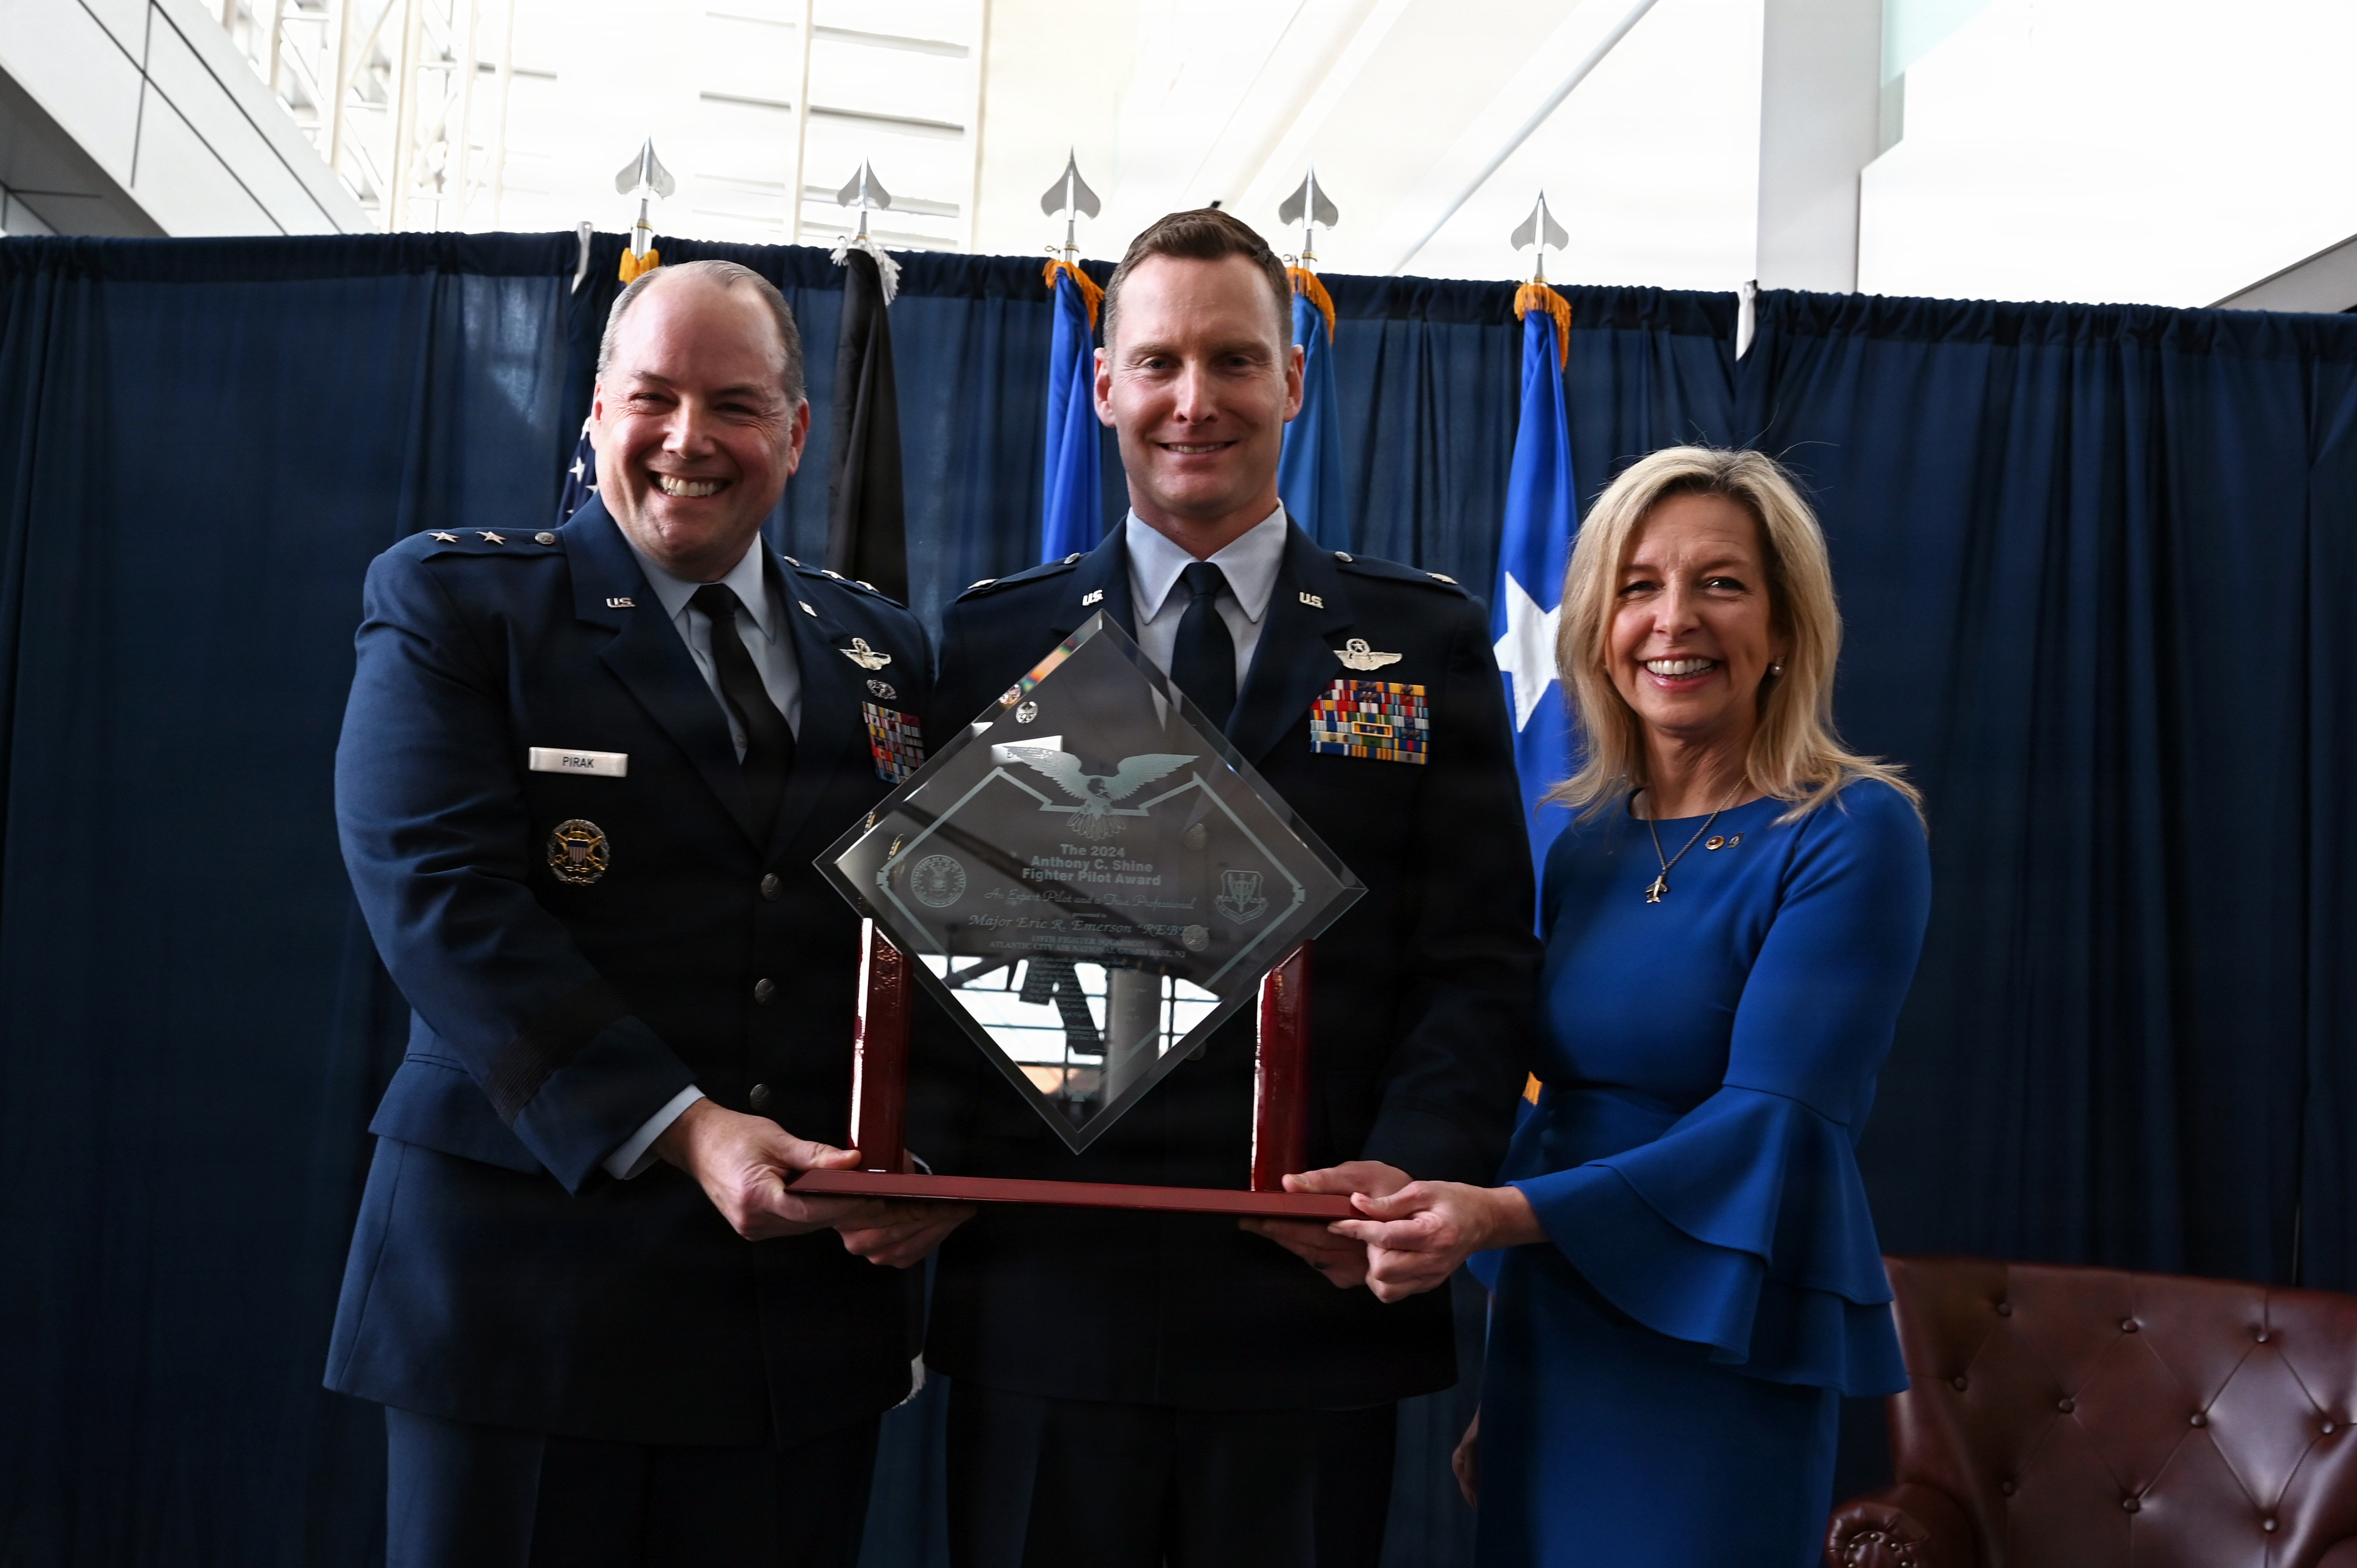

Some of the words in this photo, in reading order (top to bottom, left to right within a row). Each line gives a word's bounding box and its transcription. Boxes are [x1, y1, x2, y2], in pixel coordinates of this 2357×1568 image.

[562, 756, 594, 768] PIRAK
[1060, 844, 1087, 856] The
[1091, 846, 1126, 857] 2024
[1030, 856, 1090, 871] Anthony
[1094, 859, 1108, 870] C.
[1113, 860, 1153, 872] Shine
[1022, 868, 1074, 882] Fighter
[1078, 871, 1111, 883] Pilot
[1115, 873, 1161, 886] Award
[969, 914, 1013, 930] Major
[1016, 917, 1048, 928] Eric
[1051, 919, 1065, 932] R.
[1071, 920, 1132, 933] Emerson
